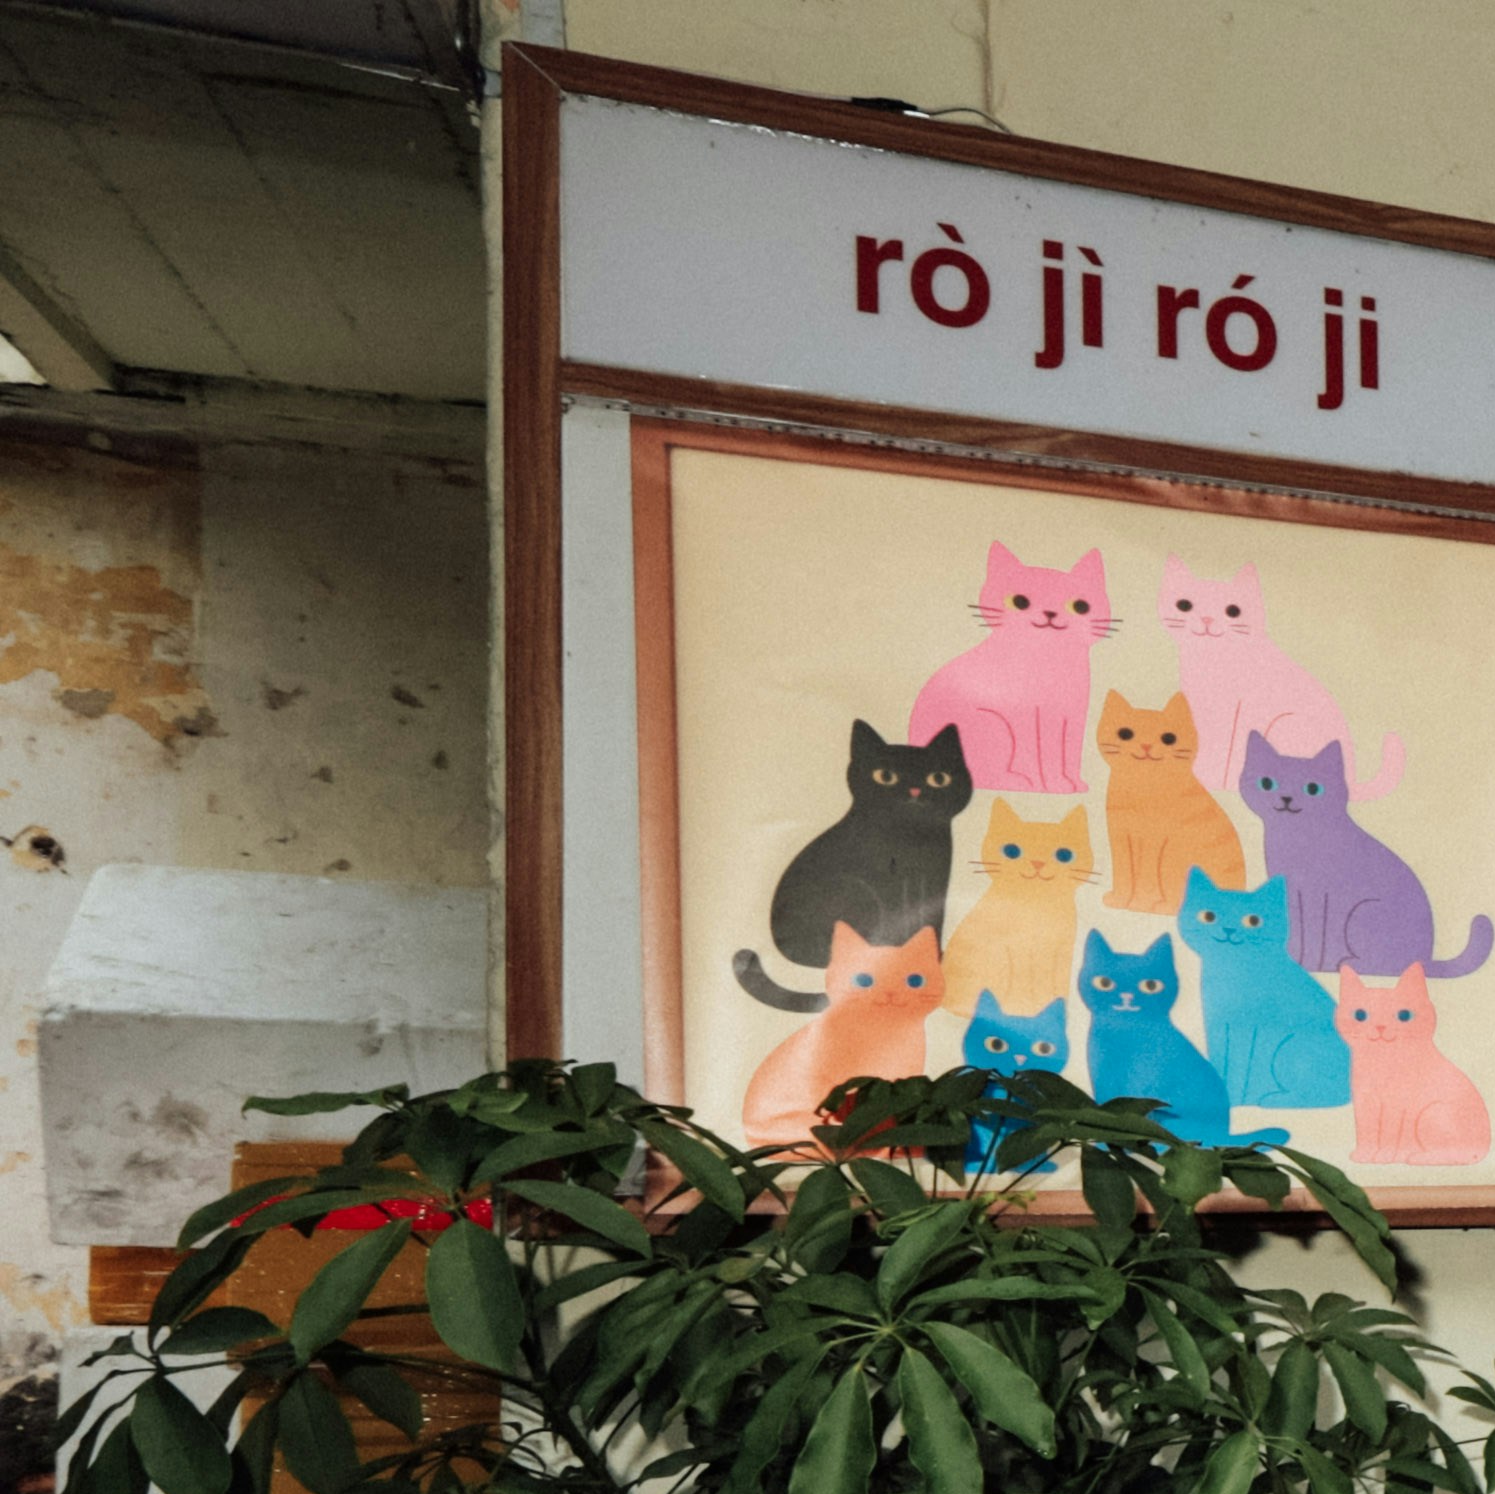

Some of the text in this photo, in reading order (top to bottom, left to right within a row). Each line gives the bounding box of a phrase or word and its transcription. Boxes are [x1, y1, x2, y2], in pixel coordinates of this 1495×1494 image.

[854, 223, 1380, 411] rò jì ró ji
